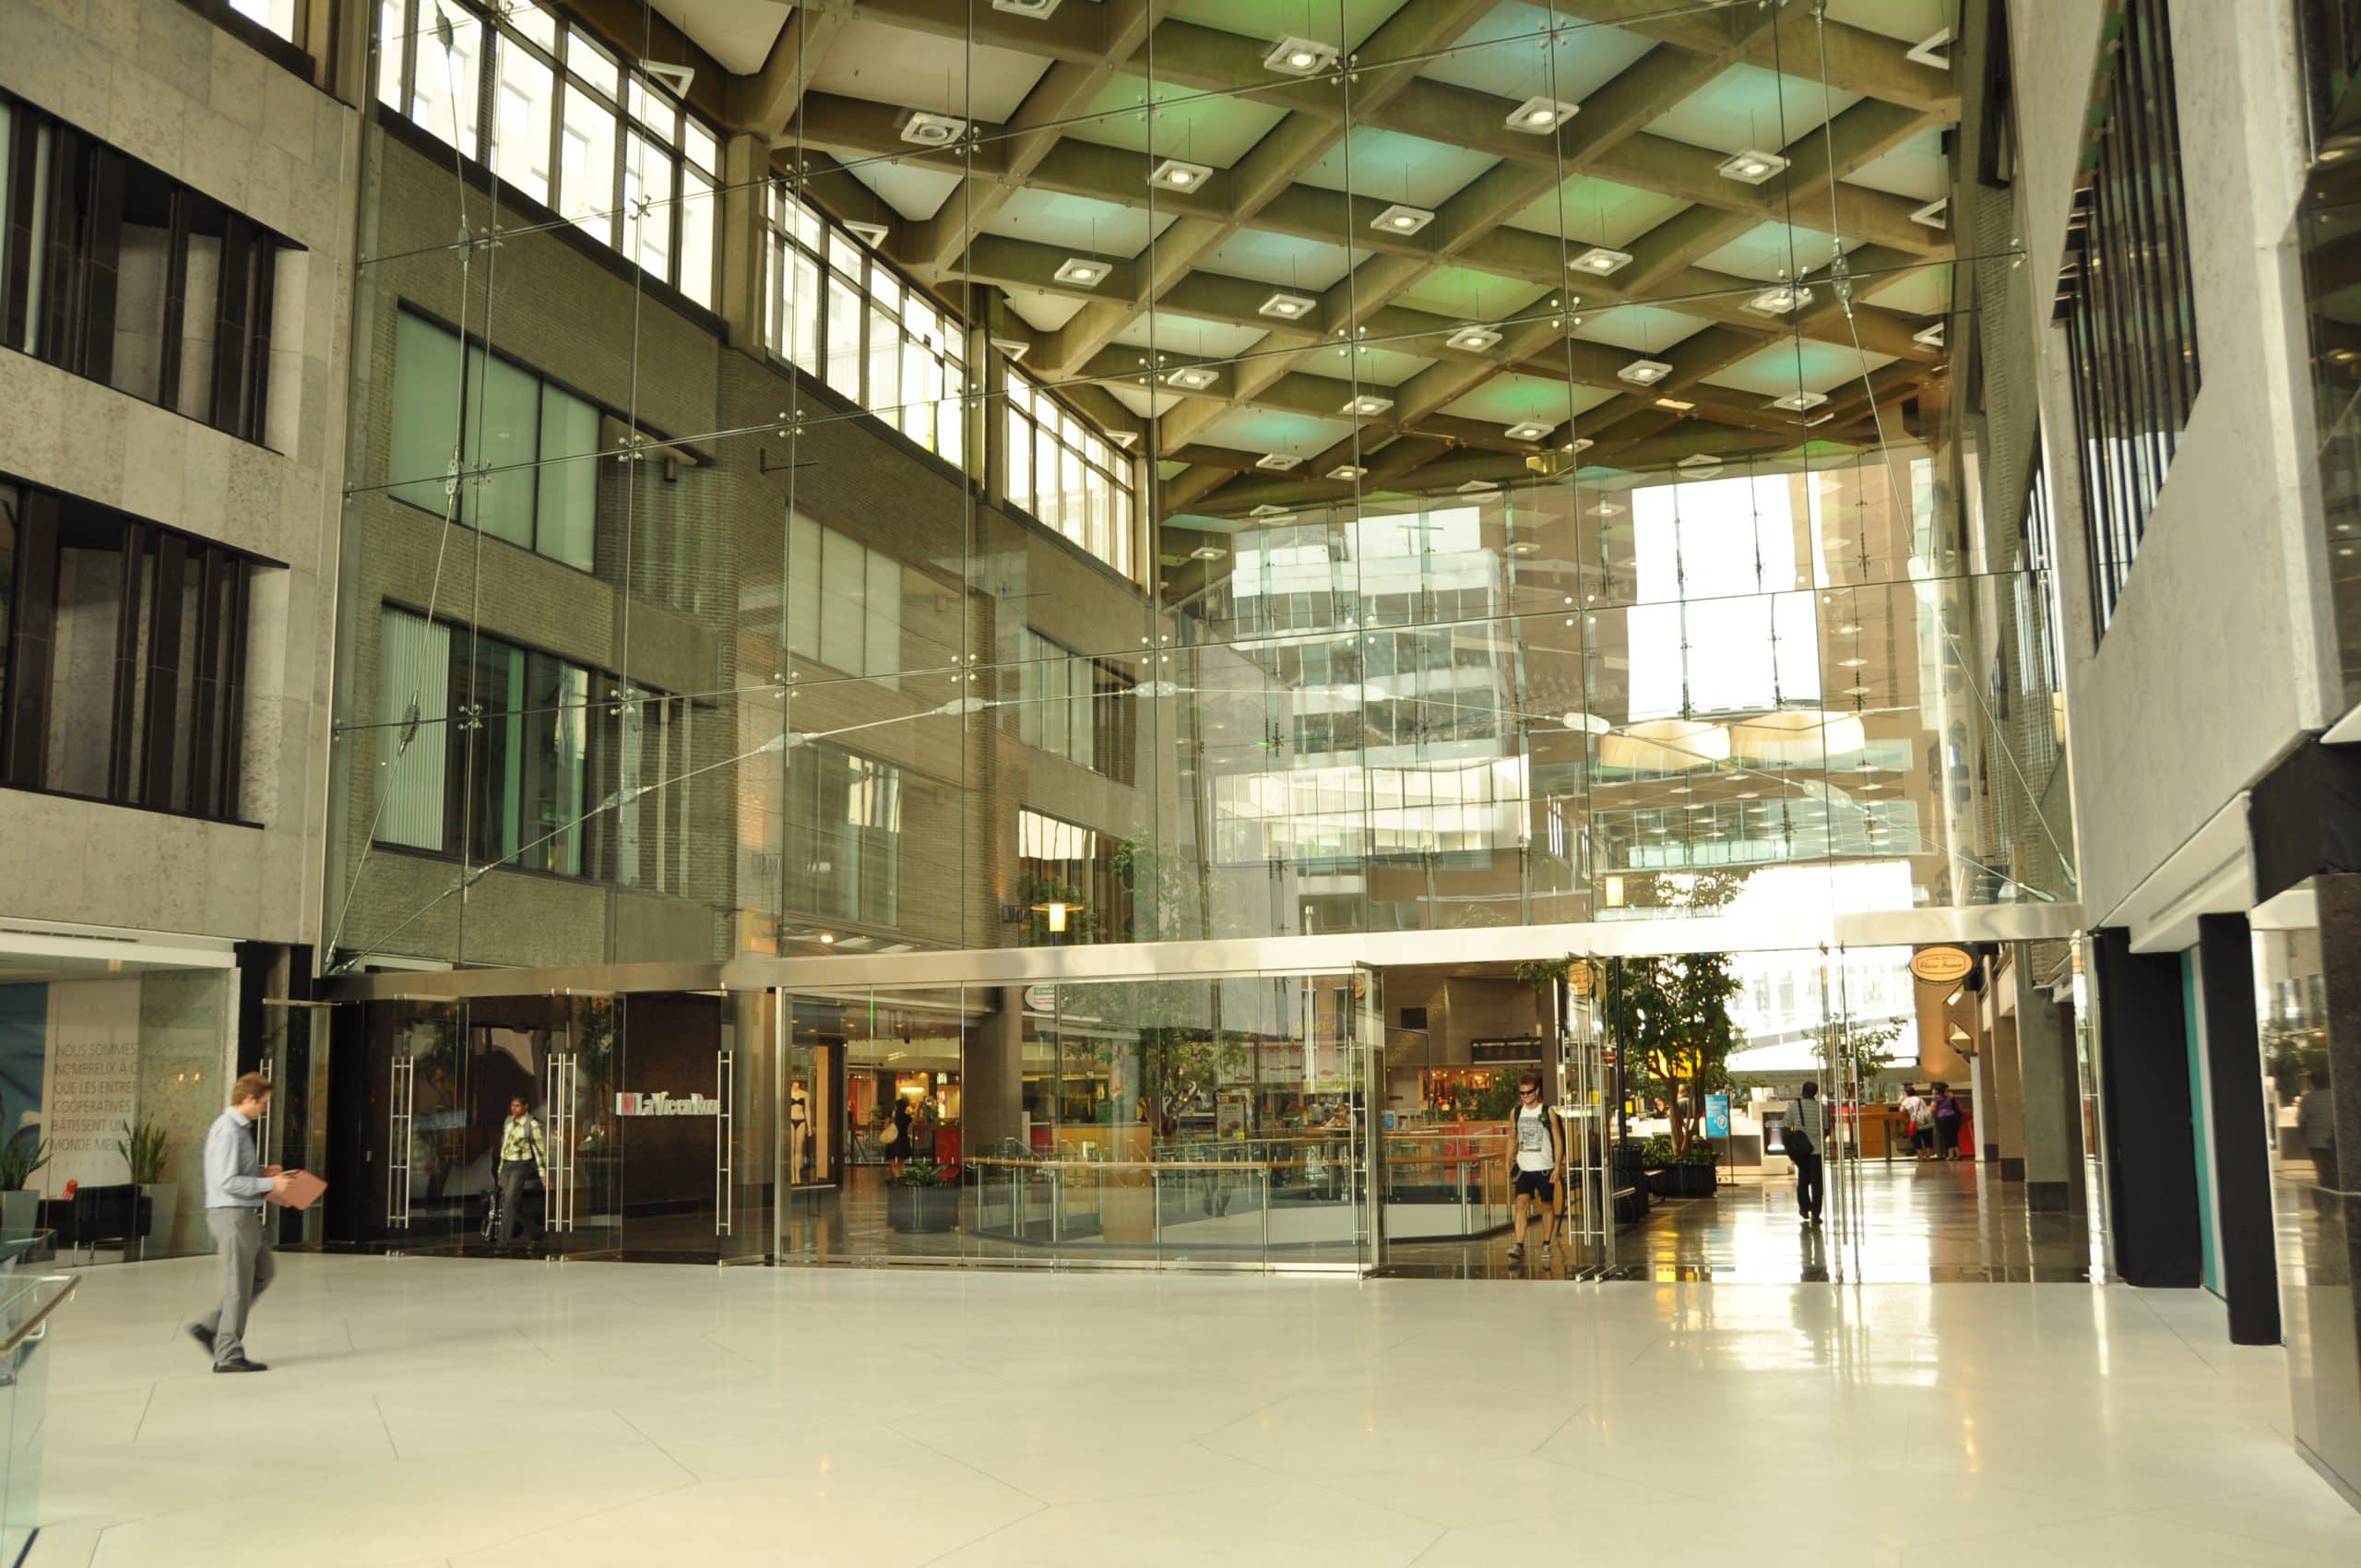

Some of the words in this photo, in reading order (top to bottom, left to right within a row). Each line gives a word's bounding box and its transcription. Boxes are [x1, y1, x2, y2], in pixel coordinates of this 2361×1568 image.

[56, 1043, 86, 1057] NOUS
[89, 1042, 136, 1056] SOMMES
[54, 1062, 116, 1076] NOMBREUX
[53, 1081, 77, 1095] QUE
[80, 1080, 96, 1094] LES
[51, 1137, 92, 1152] MONDE
